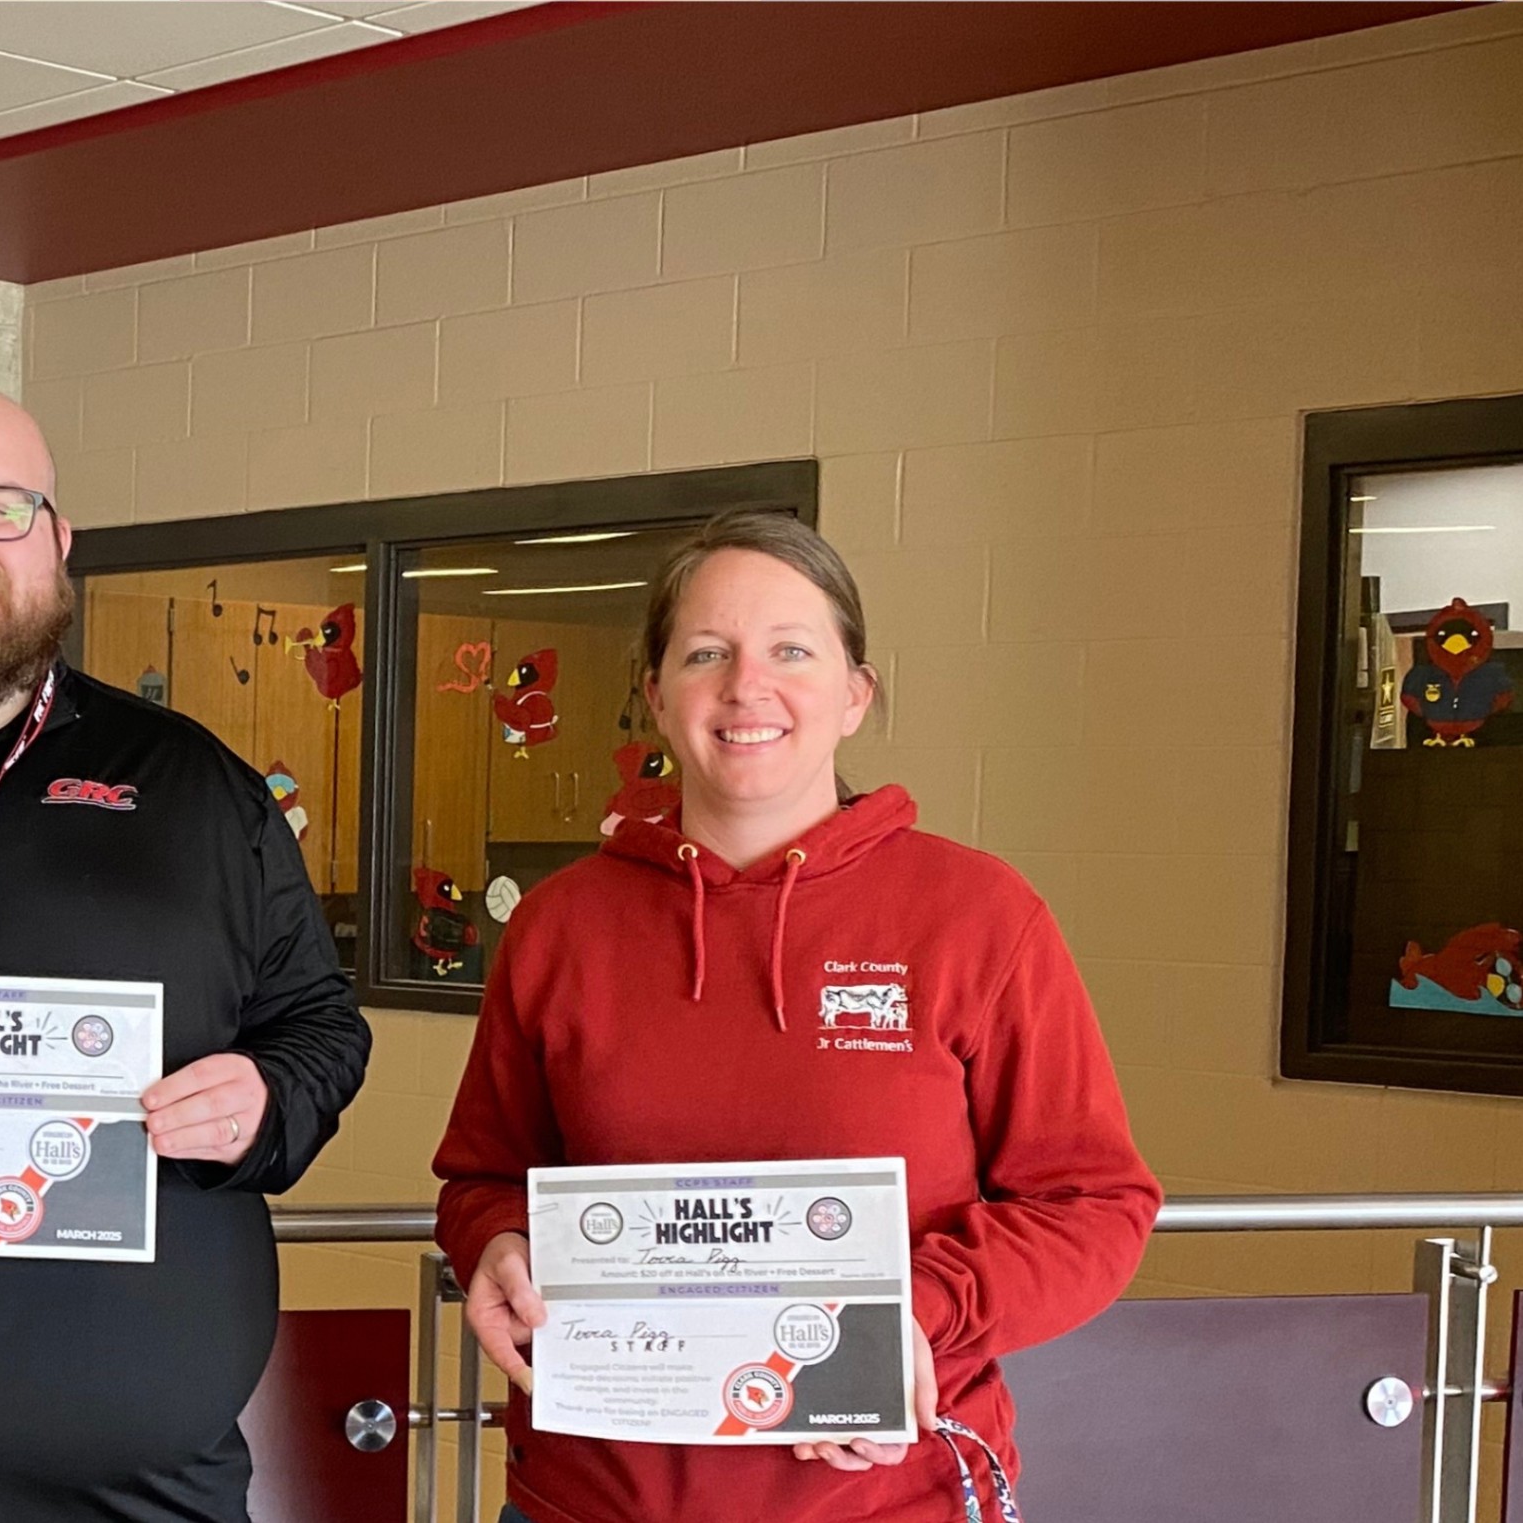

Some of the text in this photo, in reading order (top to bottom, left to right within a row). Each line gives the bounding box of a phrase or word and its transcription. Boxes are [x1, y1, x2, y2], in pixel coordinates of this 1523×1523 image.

[824, 961, 908, 975] Clark County
[816, 1038, 914, 1053] Jr Cattlemen's
[11, 1080, 33, 1089] River
[41, 1082, 60, 1090] Free
[61, 1082, 95, 1091] Dessert
[35, 1140, 81, 1159] Hall's
[674, 1198, 753, 1221] HALL'S
[56, 1229, 122, 1241] MARCH 2025
[655, 1220, 773, 1245] HIGHLIGHT
[659, 1285, 721, 1296] ENGAGED
[780, 1325, 829, 1343] Hall's
[809, 1413, 880, 1425] MARCH 2025
